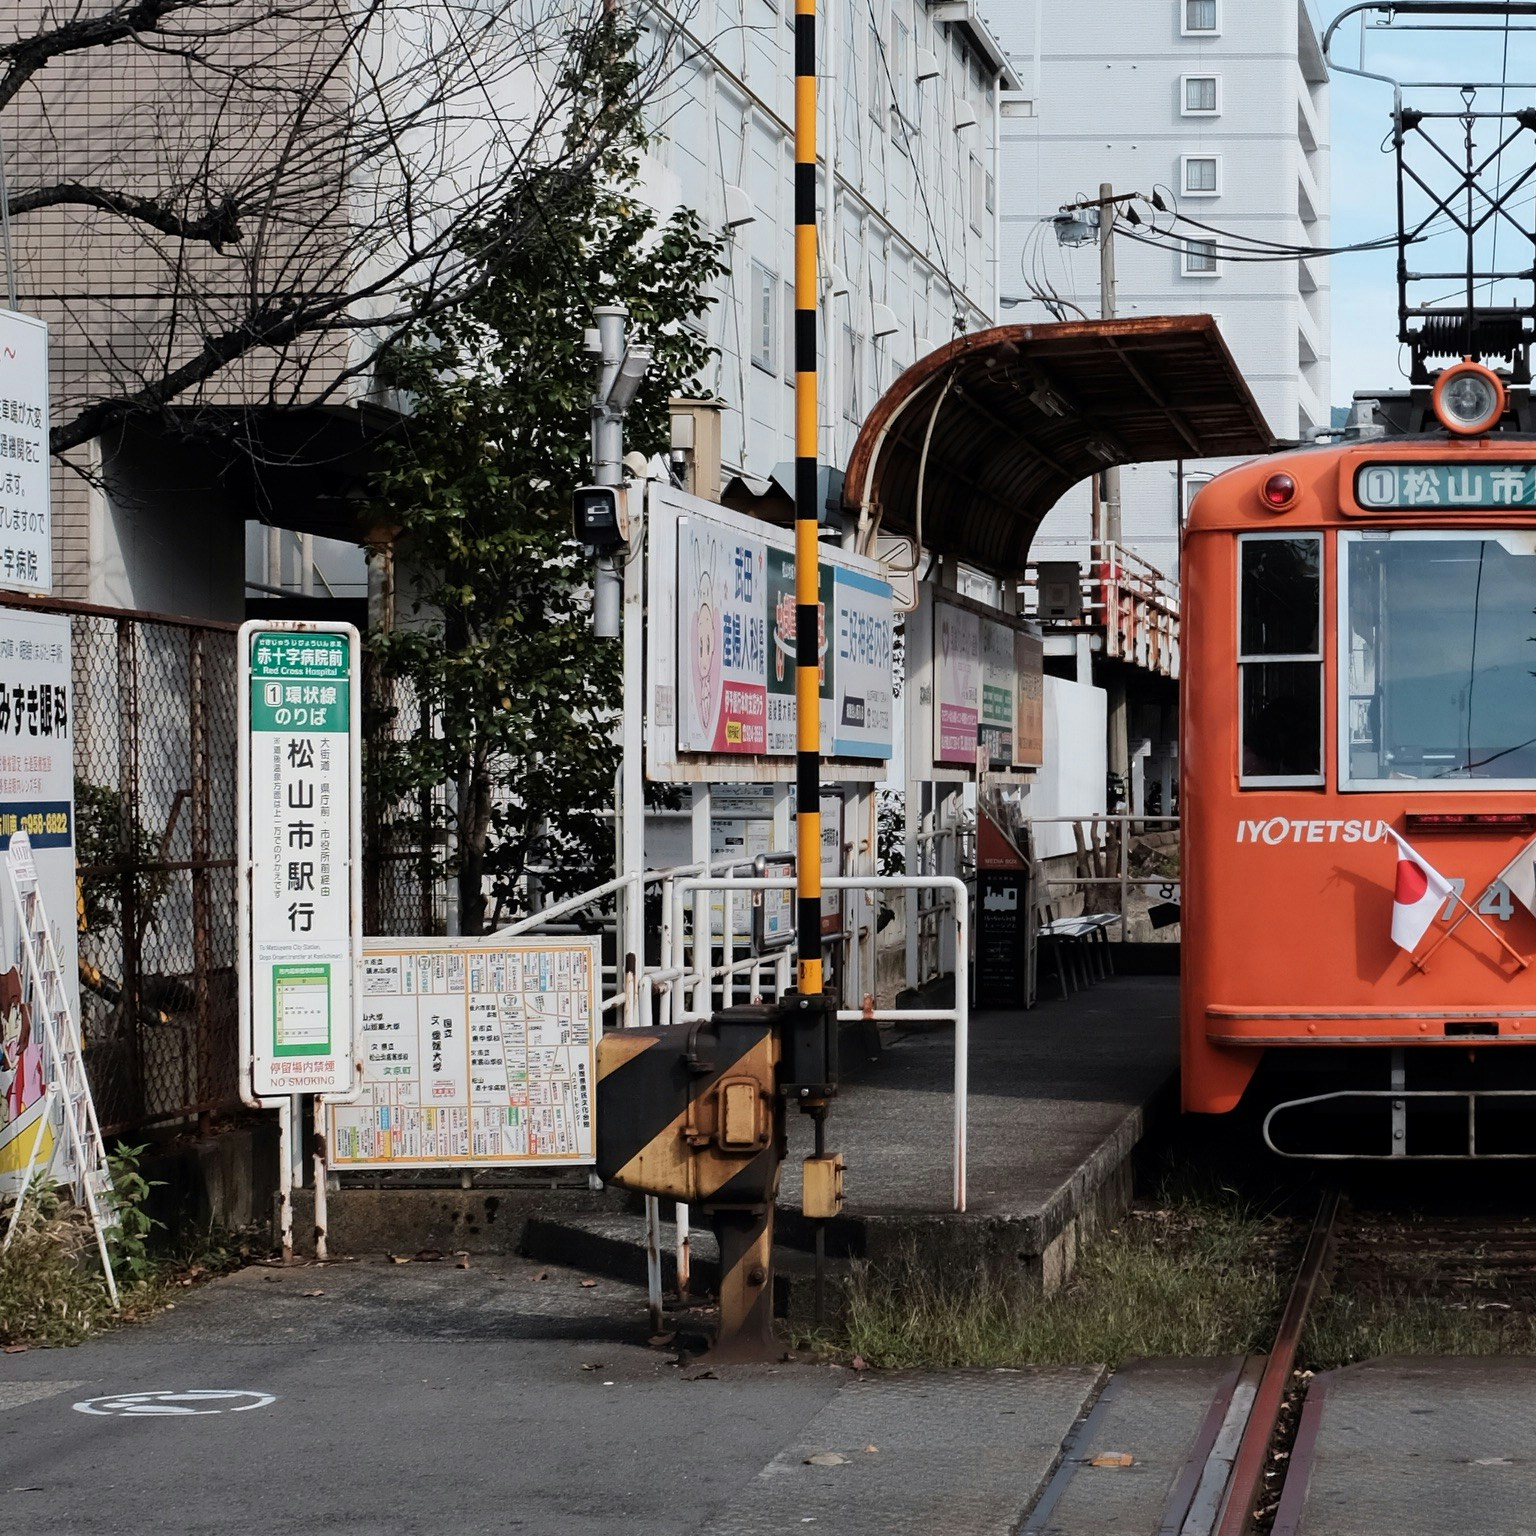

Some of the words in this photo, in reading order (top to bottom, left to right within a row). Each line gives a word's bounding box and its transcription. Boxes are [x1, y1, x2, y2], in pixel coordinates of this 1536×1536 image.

[0, 399, 42, 429] 車場が大変
[1375, 474, 1384, 499] 1
[723, 611, 759, 671] 産婦人科
[258, 648, 343, 666] 赤十字病院前
[281, 667, 303, 675] Cross
[305, 668, 337, 677] Hospital
[270, 687, 277, 702] 1
[286, 686, 336, 704] 環状線
[0, 683, 67, 739] みずき眼科
[275, 708, 327, 725] のりば
[287, 738, 315, 933] 松山市駅行
[1236, 816, 1384, 846] IYOTETSU
[1441, 877, 1515, 921] 74
[270, 1060, 335, 1075] 停留場内禁煙
[270, 1078, 285, 1087] NO
[288, 1076, 335, 1086] SMOKING
